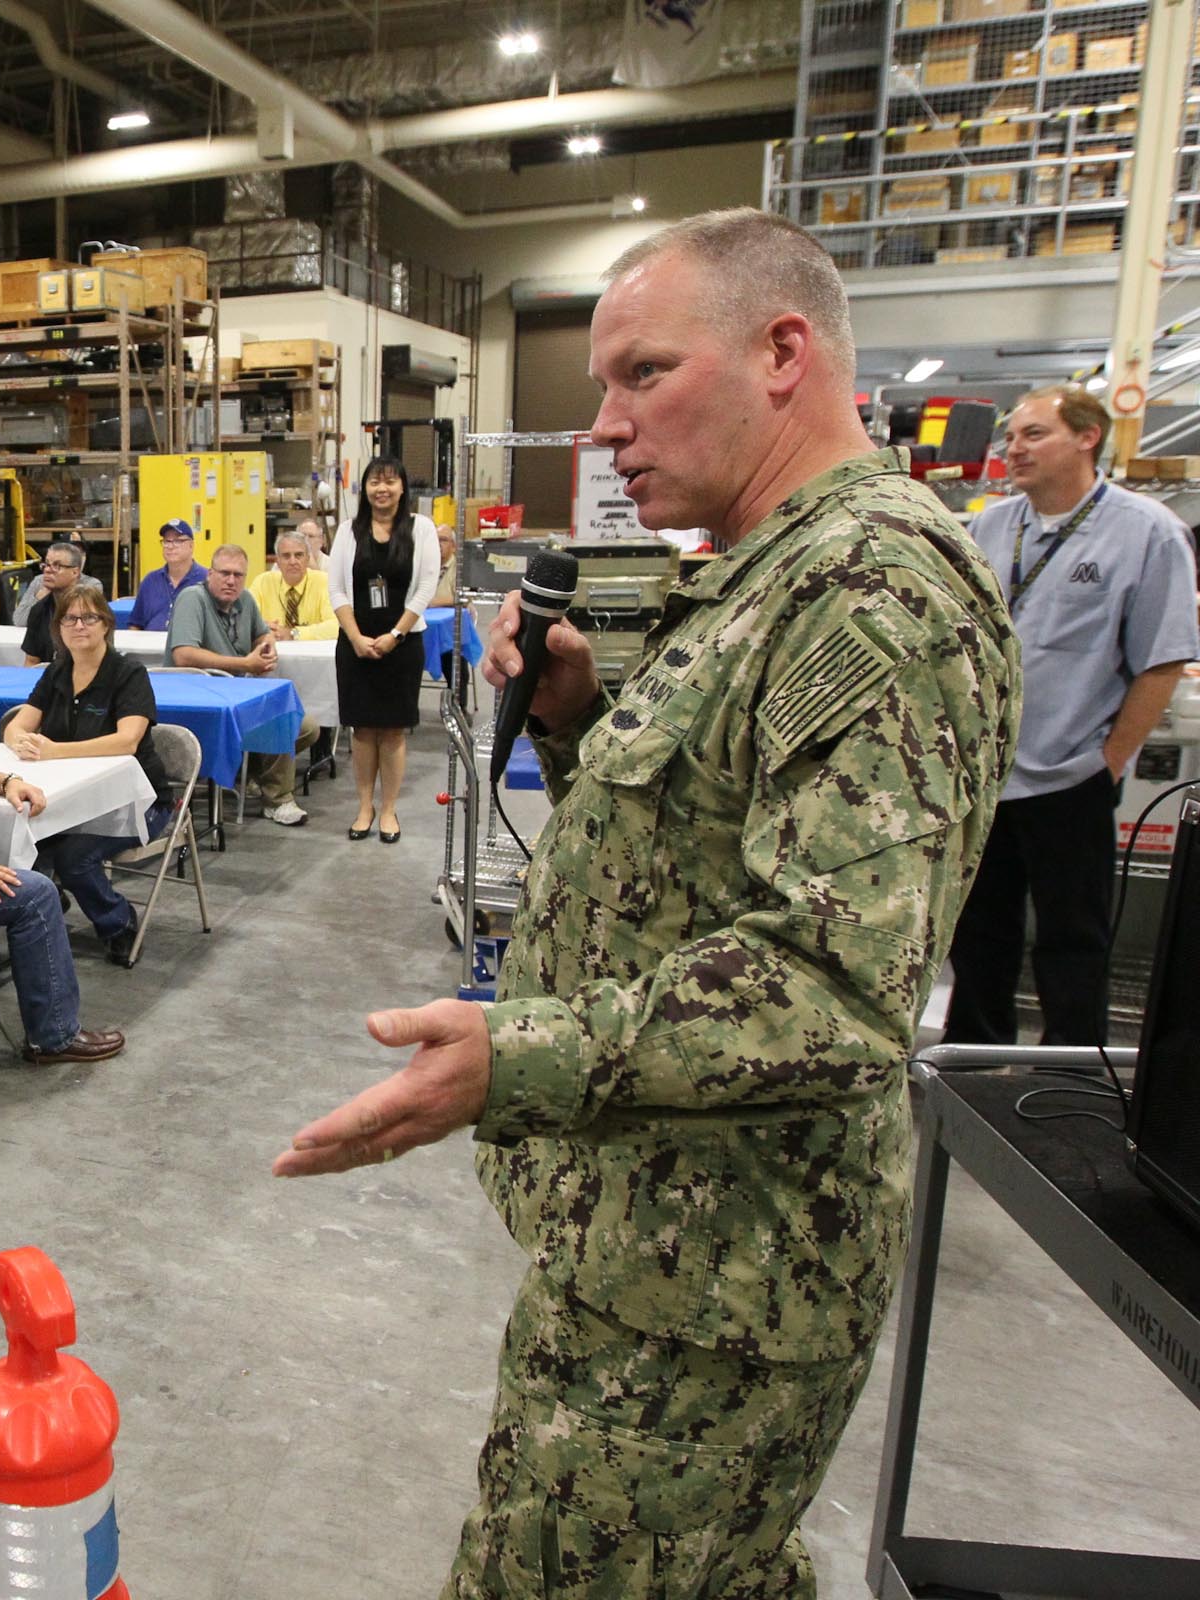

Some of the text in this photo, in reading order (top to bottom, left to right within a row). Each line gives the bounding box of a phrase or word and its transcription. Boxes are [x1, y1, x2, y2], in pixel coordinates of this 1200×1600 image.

[590, 520, 637, 530] Ready to
[646, 677, 678, 708] NAVY
[815, 689, 842, 713] TREAD
[842, 677, 855, 690] ON
[854, 667, 867, 678] ME
[1122, 832, 1167, 842] FAGILE
[1111, 1279, 1200, 1392] WAREHOU
